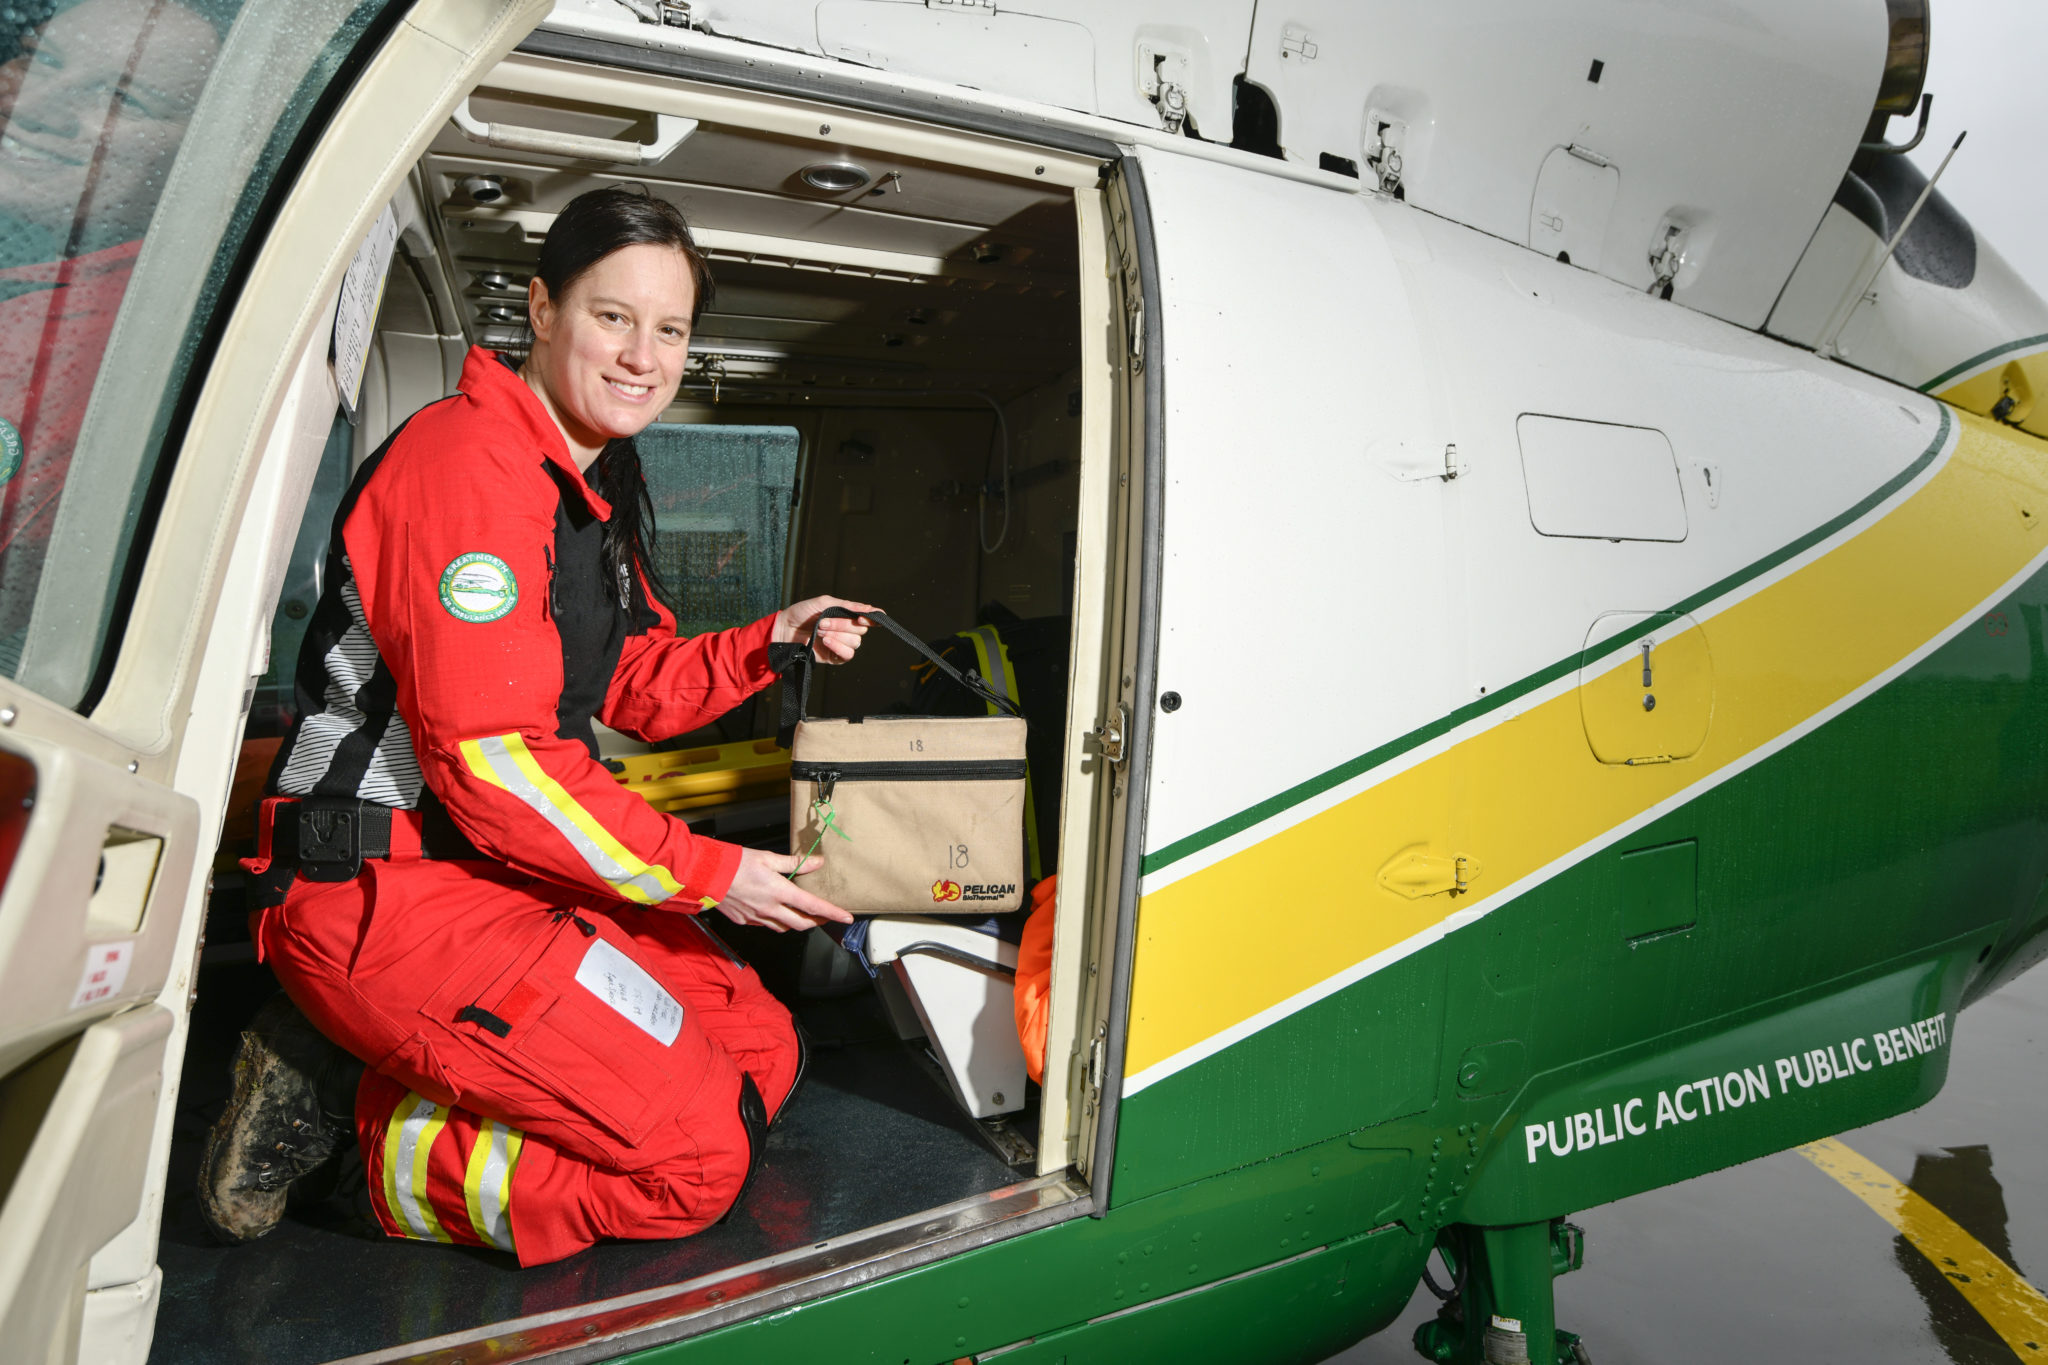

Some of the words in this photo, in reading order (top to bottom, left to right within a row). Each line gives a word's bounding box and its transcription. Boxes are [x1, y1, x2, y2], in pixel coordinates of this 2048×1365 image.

[446, 554, 474, 575] GREAT
[476, 553, 509, 573] NORTH
[451, 606, 495, 621] AMBULANCE
[910, 739, 924, 752] 18
[949, 844, 969, 869] 18
[963, 884, 1016, 895] PELICAN
[1524, 1098, 1648, 1164] PUBLIC
[1655, 1064, 1771, 1130] ACTION
[1774, 1037, 1873, 1094] PUBLIC
[1873, 1011, 1946, 1066] BENEFIT
